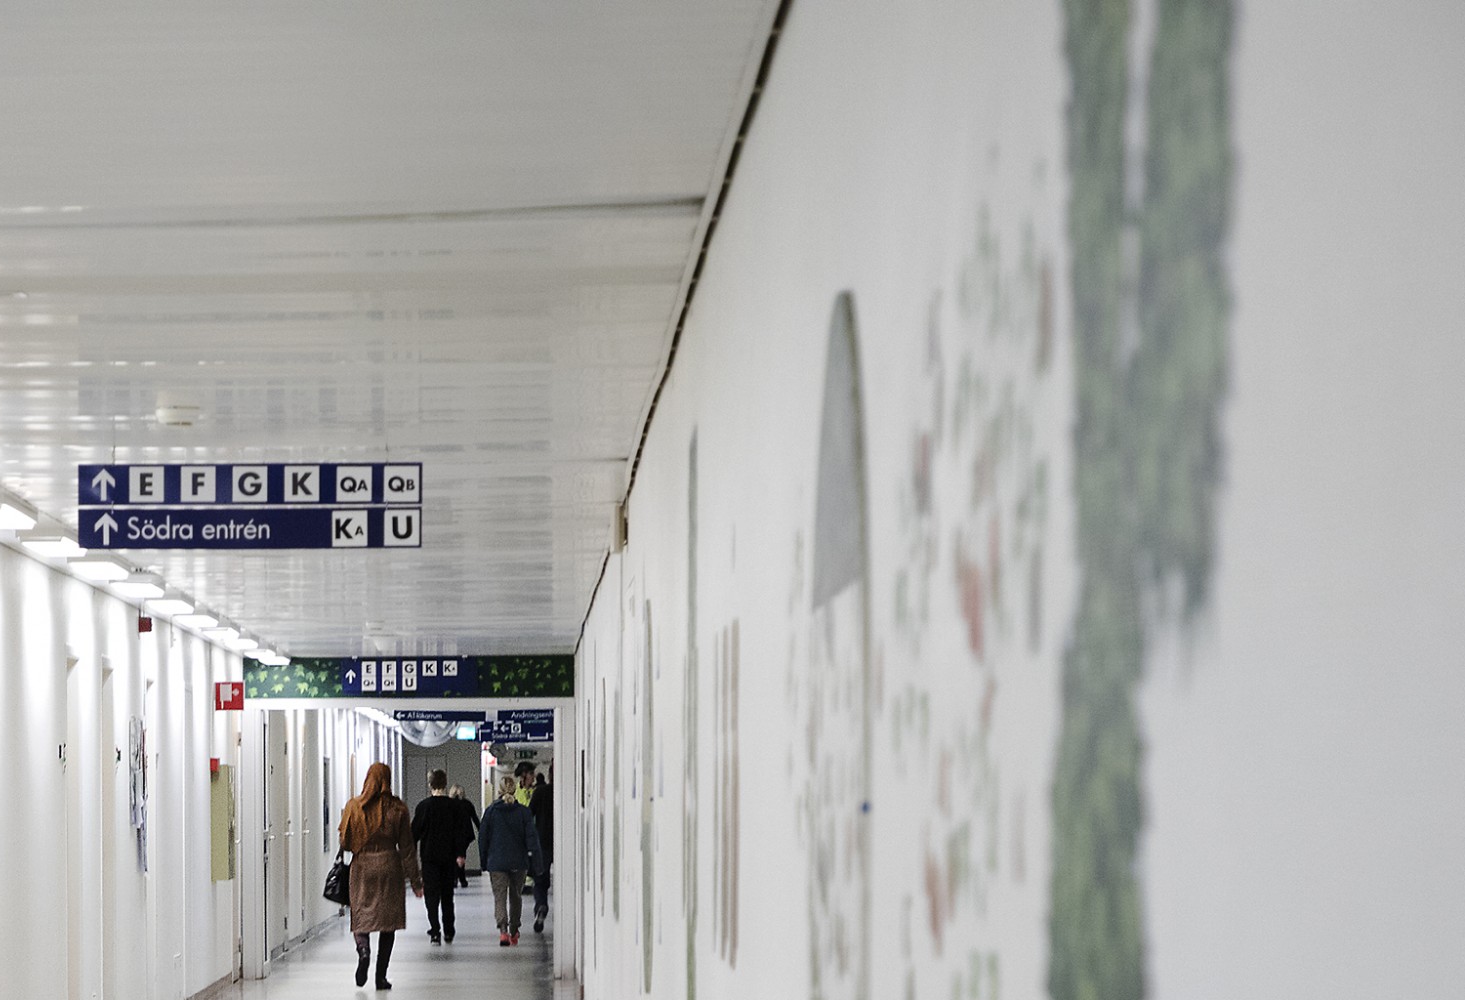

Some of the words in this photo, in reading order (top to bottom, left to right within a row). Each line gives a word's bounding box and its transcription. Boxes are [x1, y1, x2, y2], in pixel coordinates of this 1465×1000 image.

[139, 472, 153, 496] E
[191, 472, 205, 496] F
[237, 471, 262, 496] G
[291, 472, 313, 496] K
[127, 514, 193, 540] Södra
[201, 518, 270, 540] entrén
[392, 515, 413, 540] U
[366, 664, 372, 674] E
[386, 664, 392, 674] F
[404, 663, 414, 674] G
[425, 663, 434, 674] K
[405, 678, 414, 688] U
